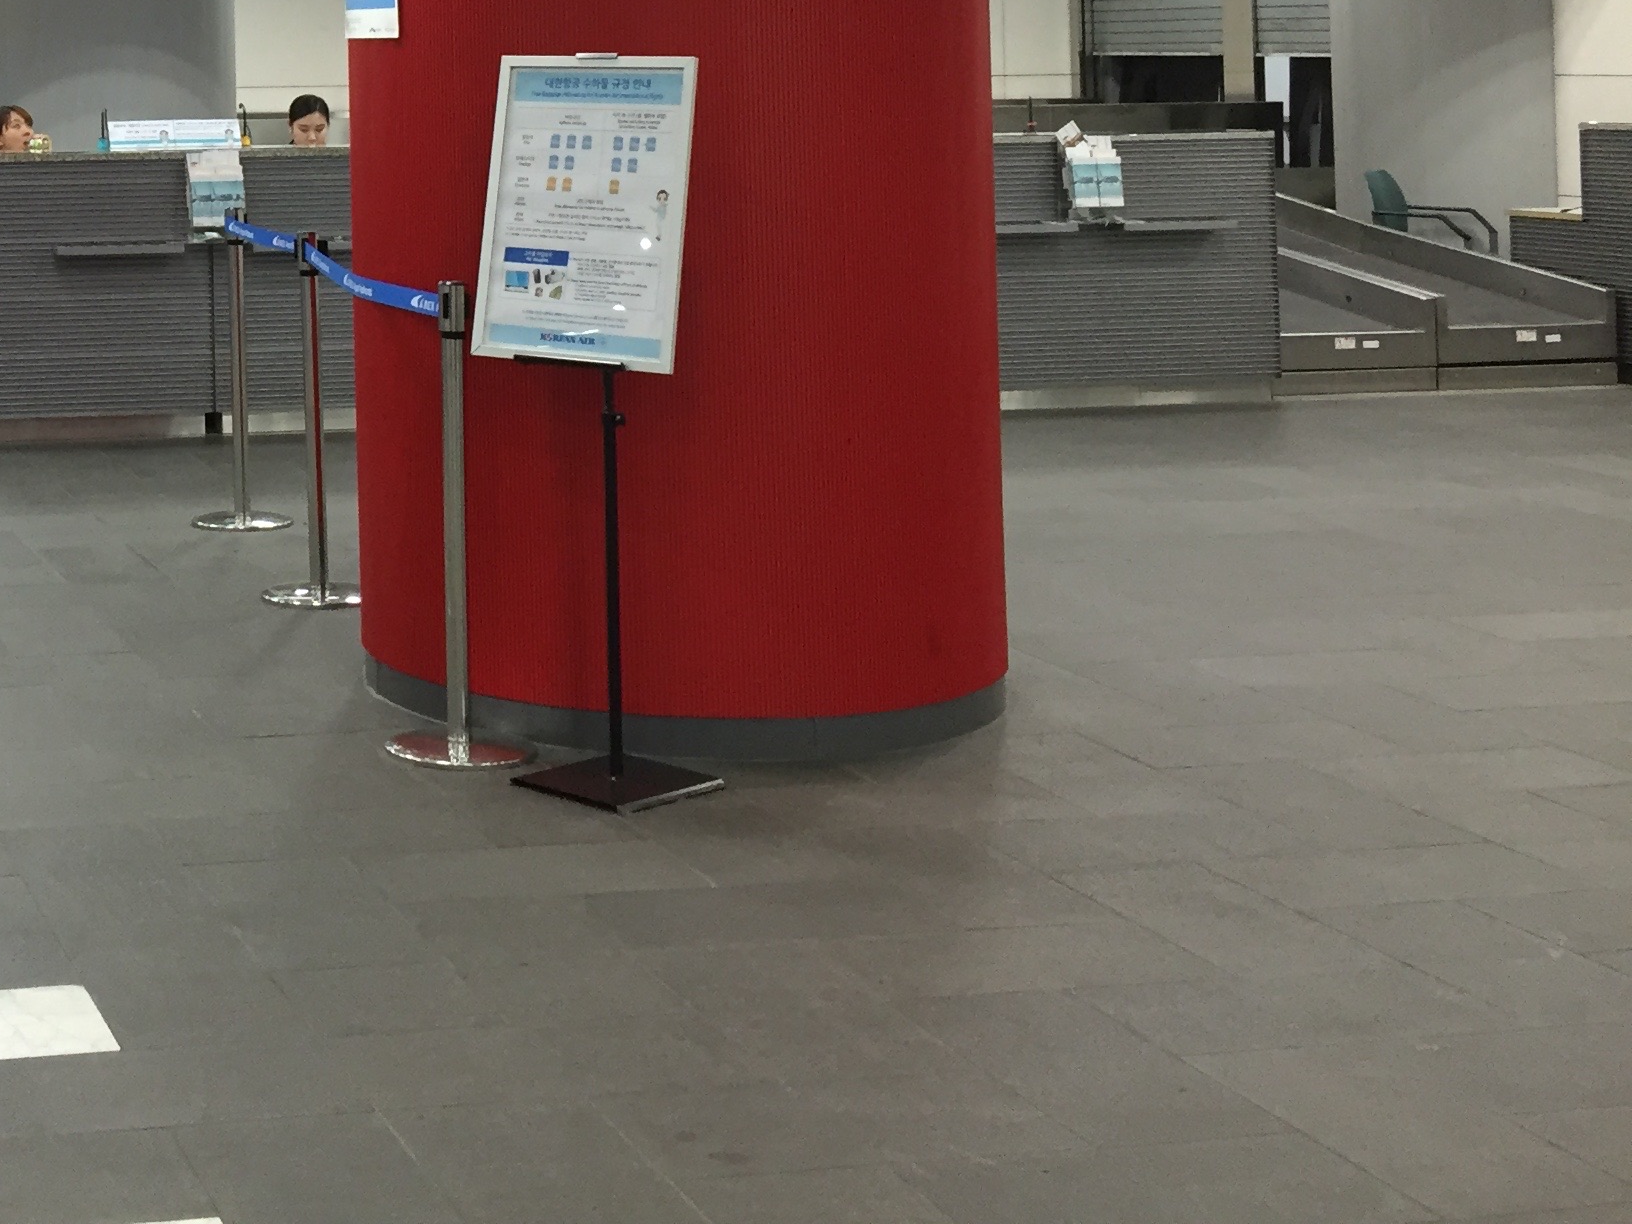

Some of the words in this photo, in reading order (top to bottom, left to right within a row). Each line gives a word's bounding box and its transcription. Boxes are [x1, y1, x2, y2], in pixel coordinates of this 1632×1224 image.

[544, 77, 581, 90] 대한항공
[632, 78, 652, 91] 안내
[539, 332, 576, 345] KOREAN
[576, 334, 596, 346] AIR
